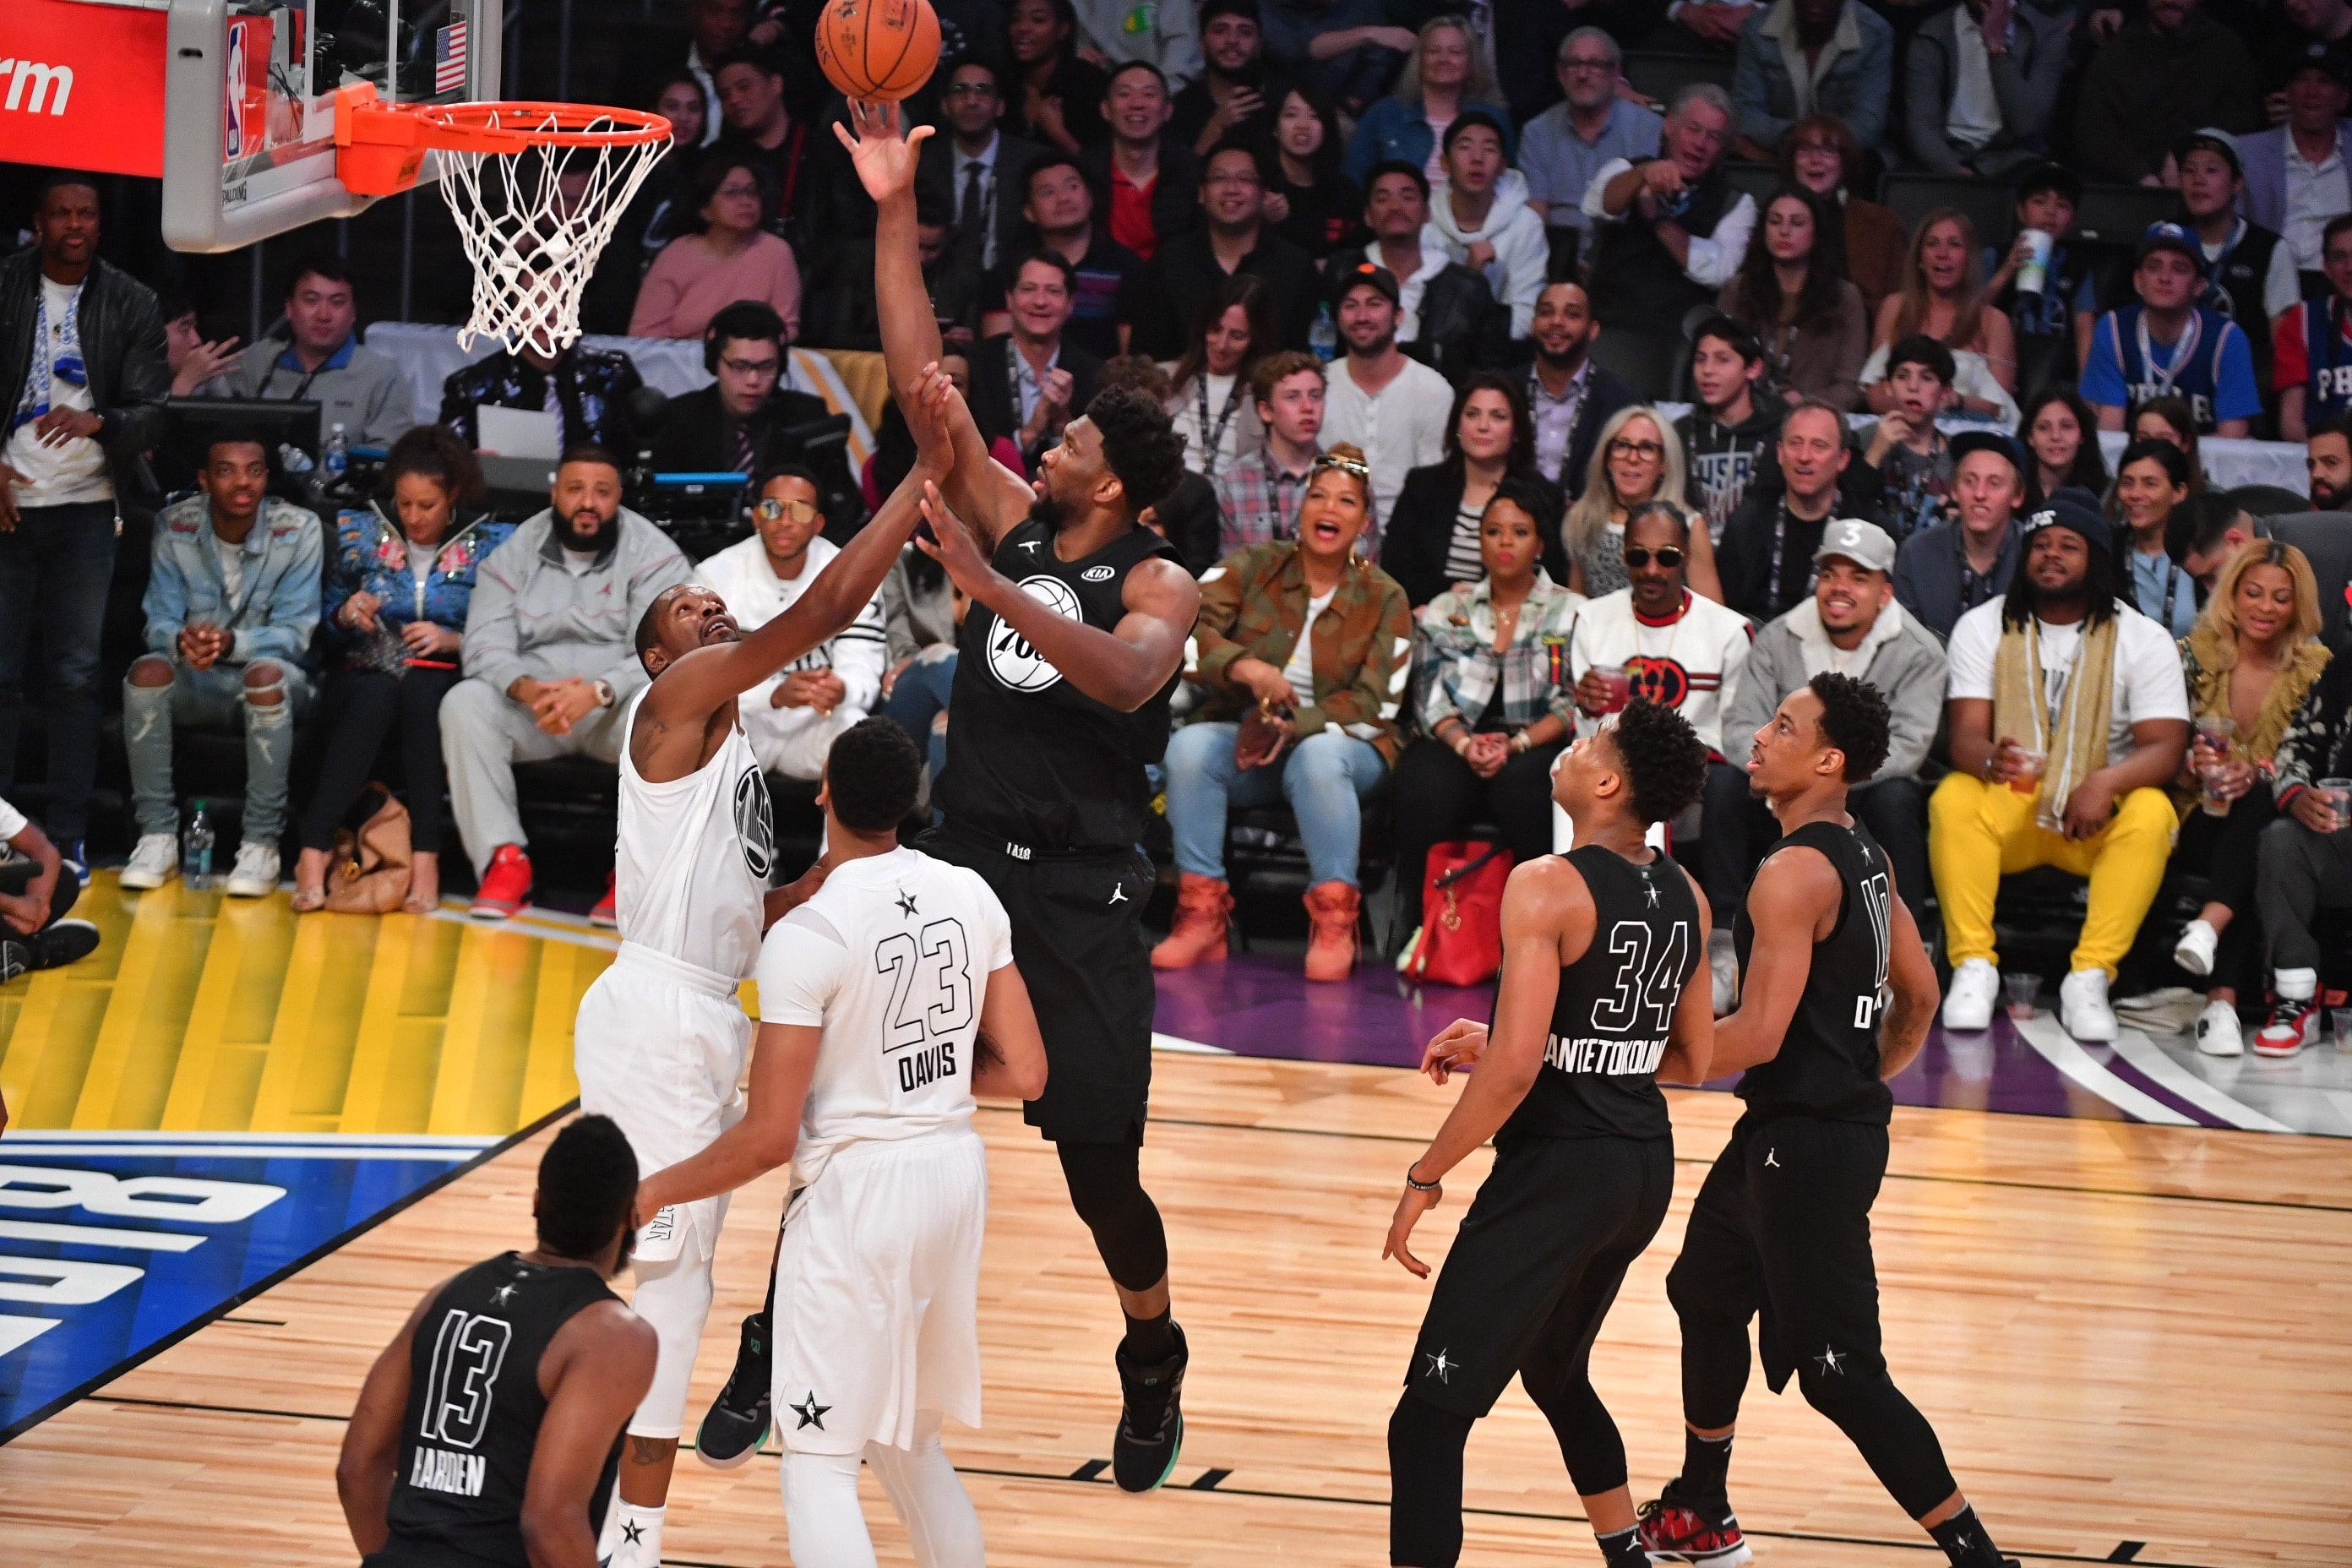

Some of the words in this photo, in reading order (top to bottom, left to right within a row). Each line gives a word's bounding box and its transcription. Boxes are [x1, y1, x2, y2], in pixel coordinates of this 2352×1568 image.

[0, 57, 74, 116] rm
[221, 180, 248, 207] PALDING
[1839, 523, 1862, 547] 3
[875, 917, 973, 1054] 23
[1590, 921, 1688, 1032] 34
[898, 1041, 956, 1092] DAVIS
[420, 1309, 512, 1449] 13
[409, 1446, 486, 1497] HARDEN
